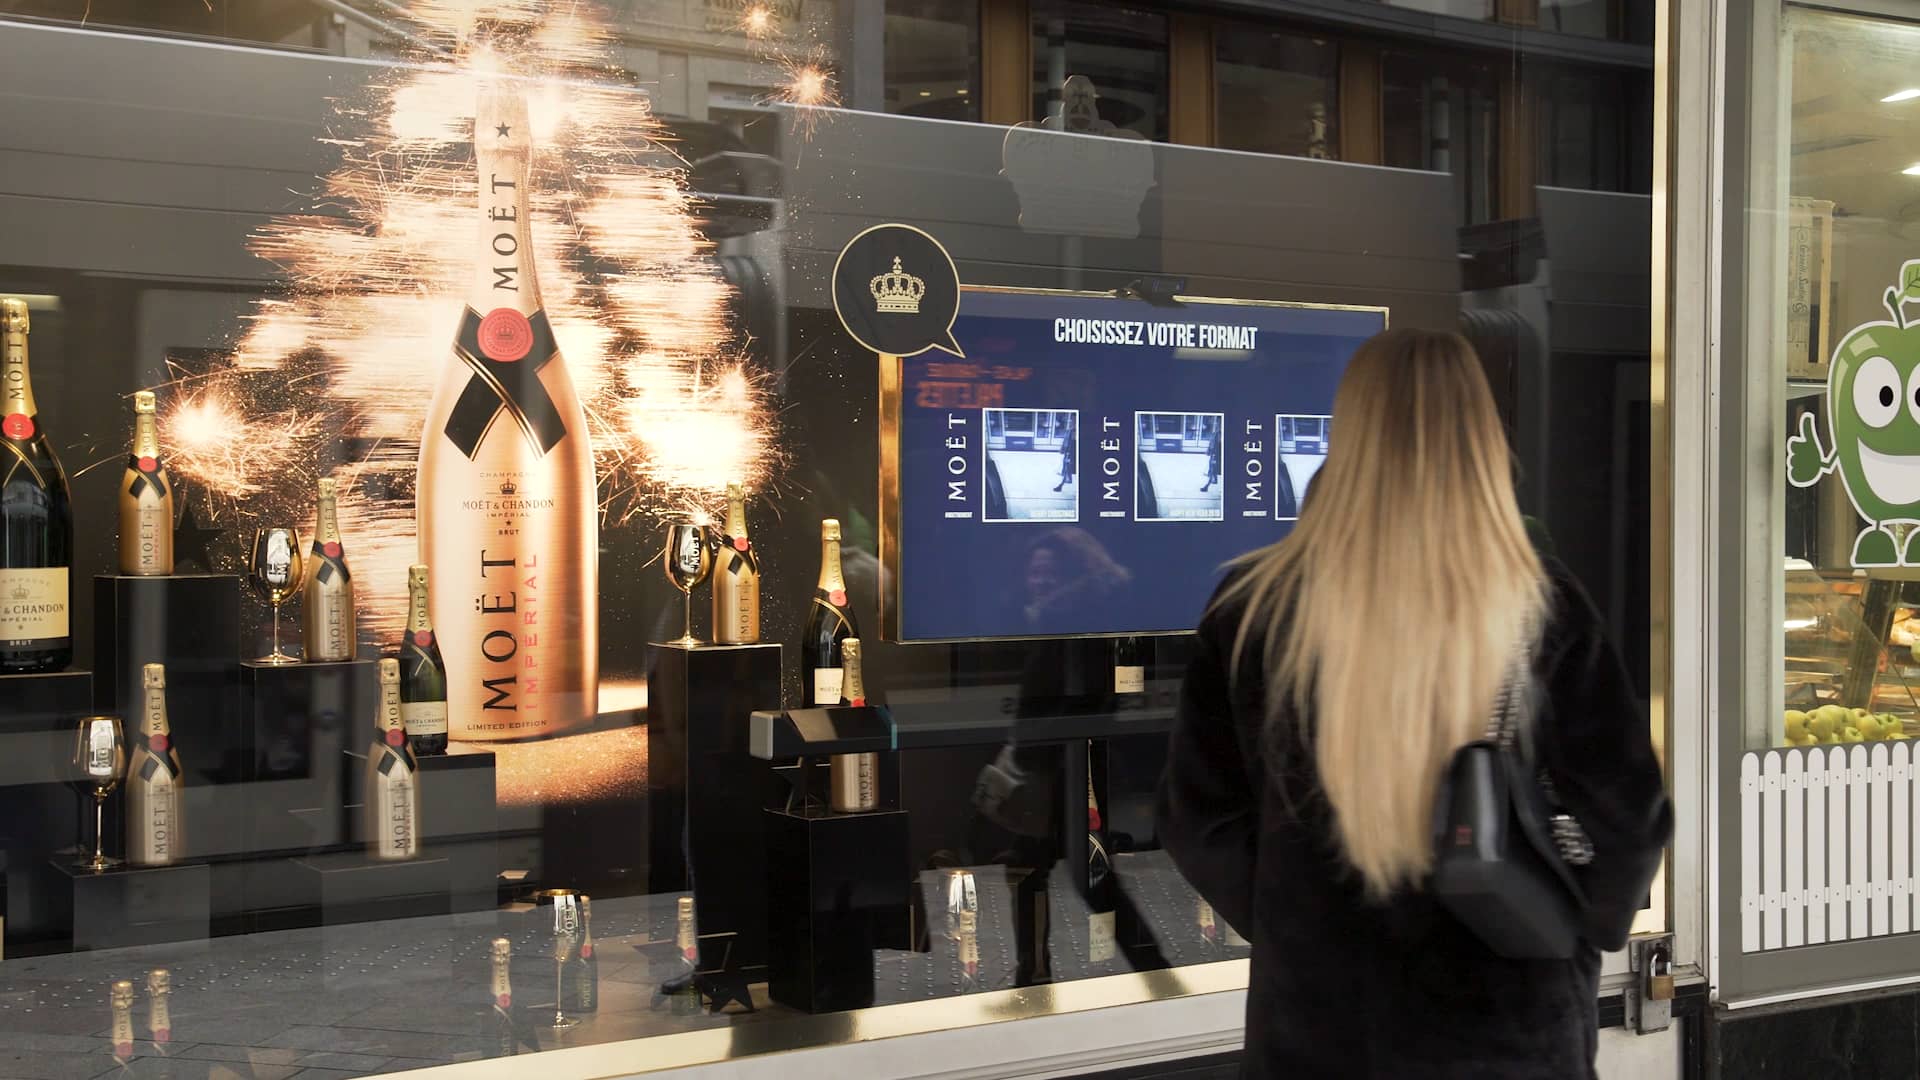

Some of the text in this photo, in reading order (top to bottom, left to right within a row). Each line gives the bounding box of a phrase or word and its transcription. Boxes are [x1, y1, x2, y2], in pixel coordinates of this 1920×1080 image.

[488, 173, 518, 292] MOËT
[1054, 317, 1258, 350] CHOISISSEZ VOTRE FORMAT
[945, 413, 967, 501] MOËT
[1101, 416, 1120, 501] MOËT
[1243, 419, 1262, 500] MOËT
[502, 499, 554, 511] CHANDON
[13, 603, 64, 614] CHANDON
[475, 549, 518, 712] MOËT
[523, 554, 538, 711] IMPERIAL
[467, 719, 547, 731] LIMITED EDITION
